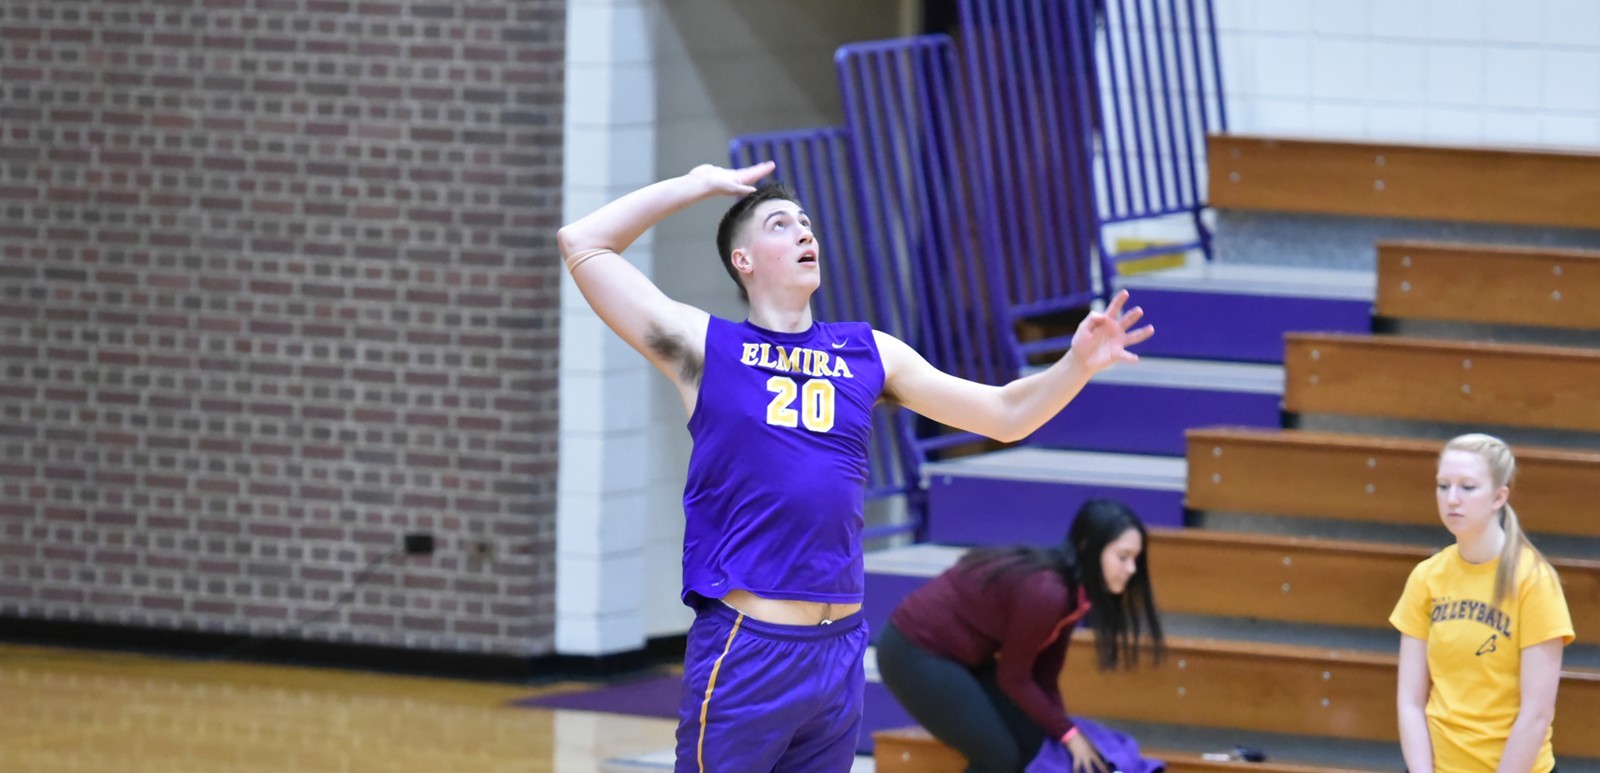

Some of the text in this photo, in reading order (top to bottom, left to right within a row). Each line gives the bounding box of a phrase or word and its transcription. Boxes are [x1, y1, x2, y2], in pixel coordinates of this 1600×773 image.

[740, 342, 854, 378] ELMIRA
[766, 376, 835, 433] 20
[1431, 600, 1511, 638] OLLEYBALL
